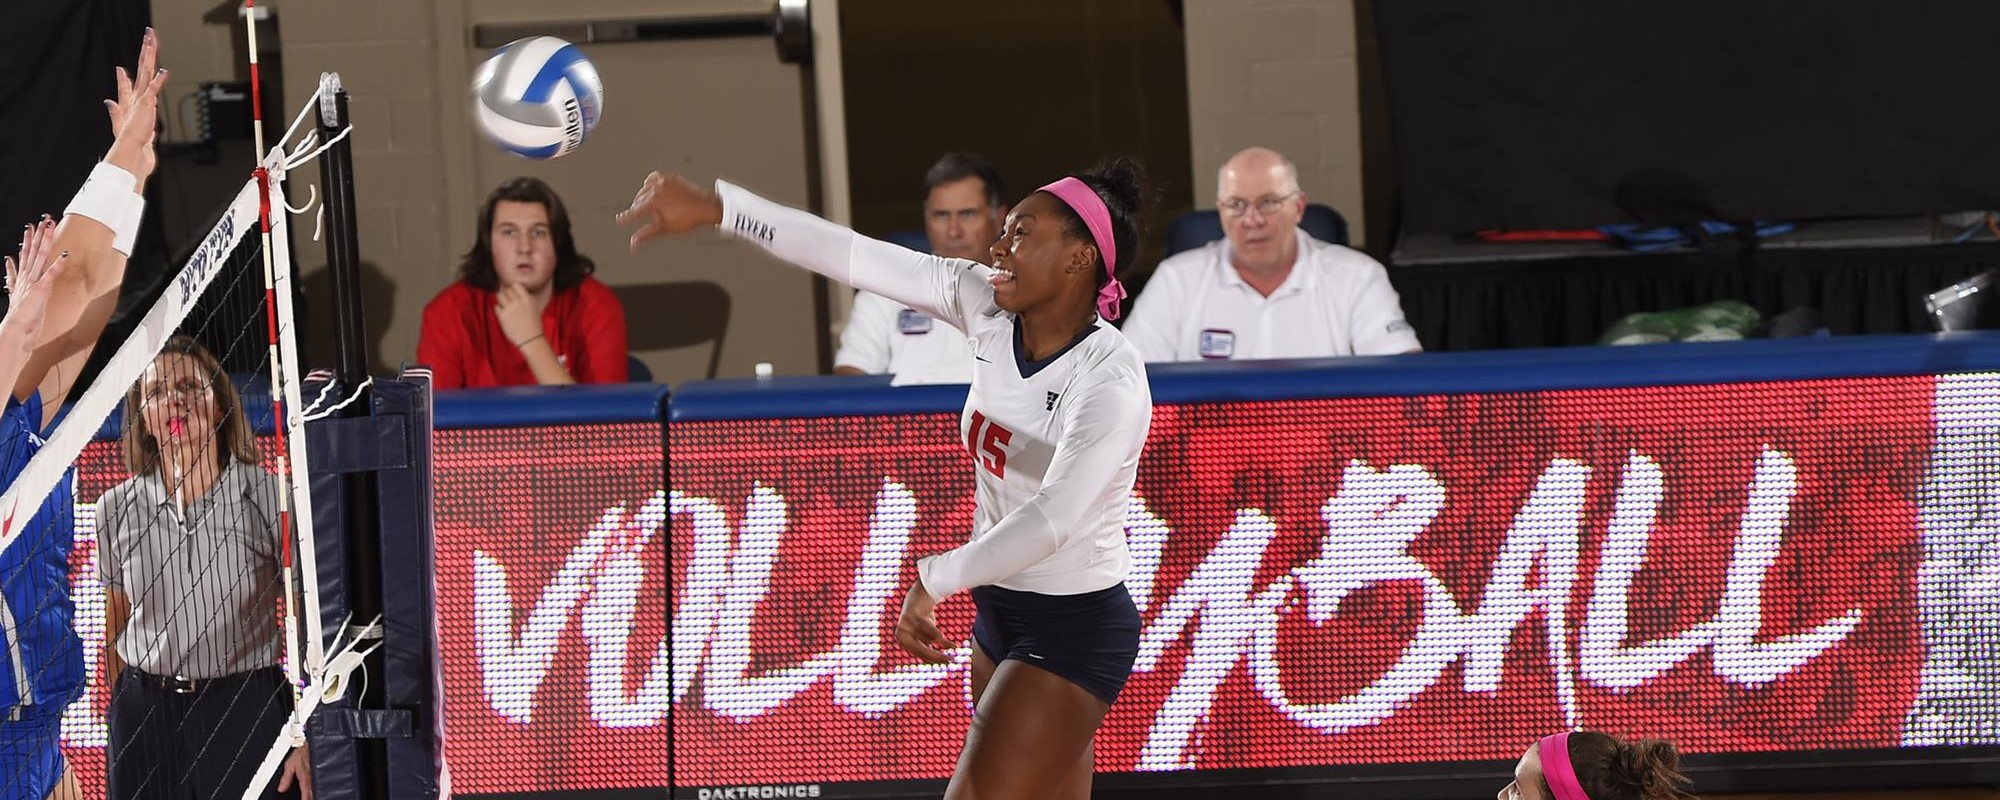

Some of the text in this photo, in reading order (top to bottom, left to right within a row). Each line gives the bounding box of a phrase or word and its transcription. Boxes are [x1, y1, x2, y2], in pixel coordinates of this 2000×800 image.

[734, 212, 777, 241] FLYERS
[967, 409, 1013, 480] 15
[473, 443, 1864, 773] VOLLYBALL
[698, 784, 821, 800] DAKTRONICS
